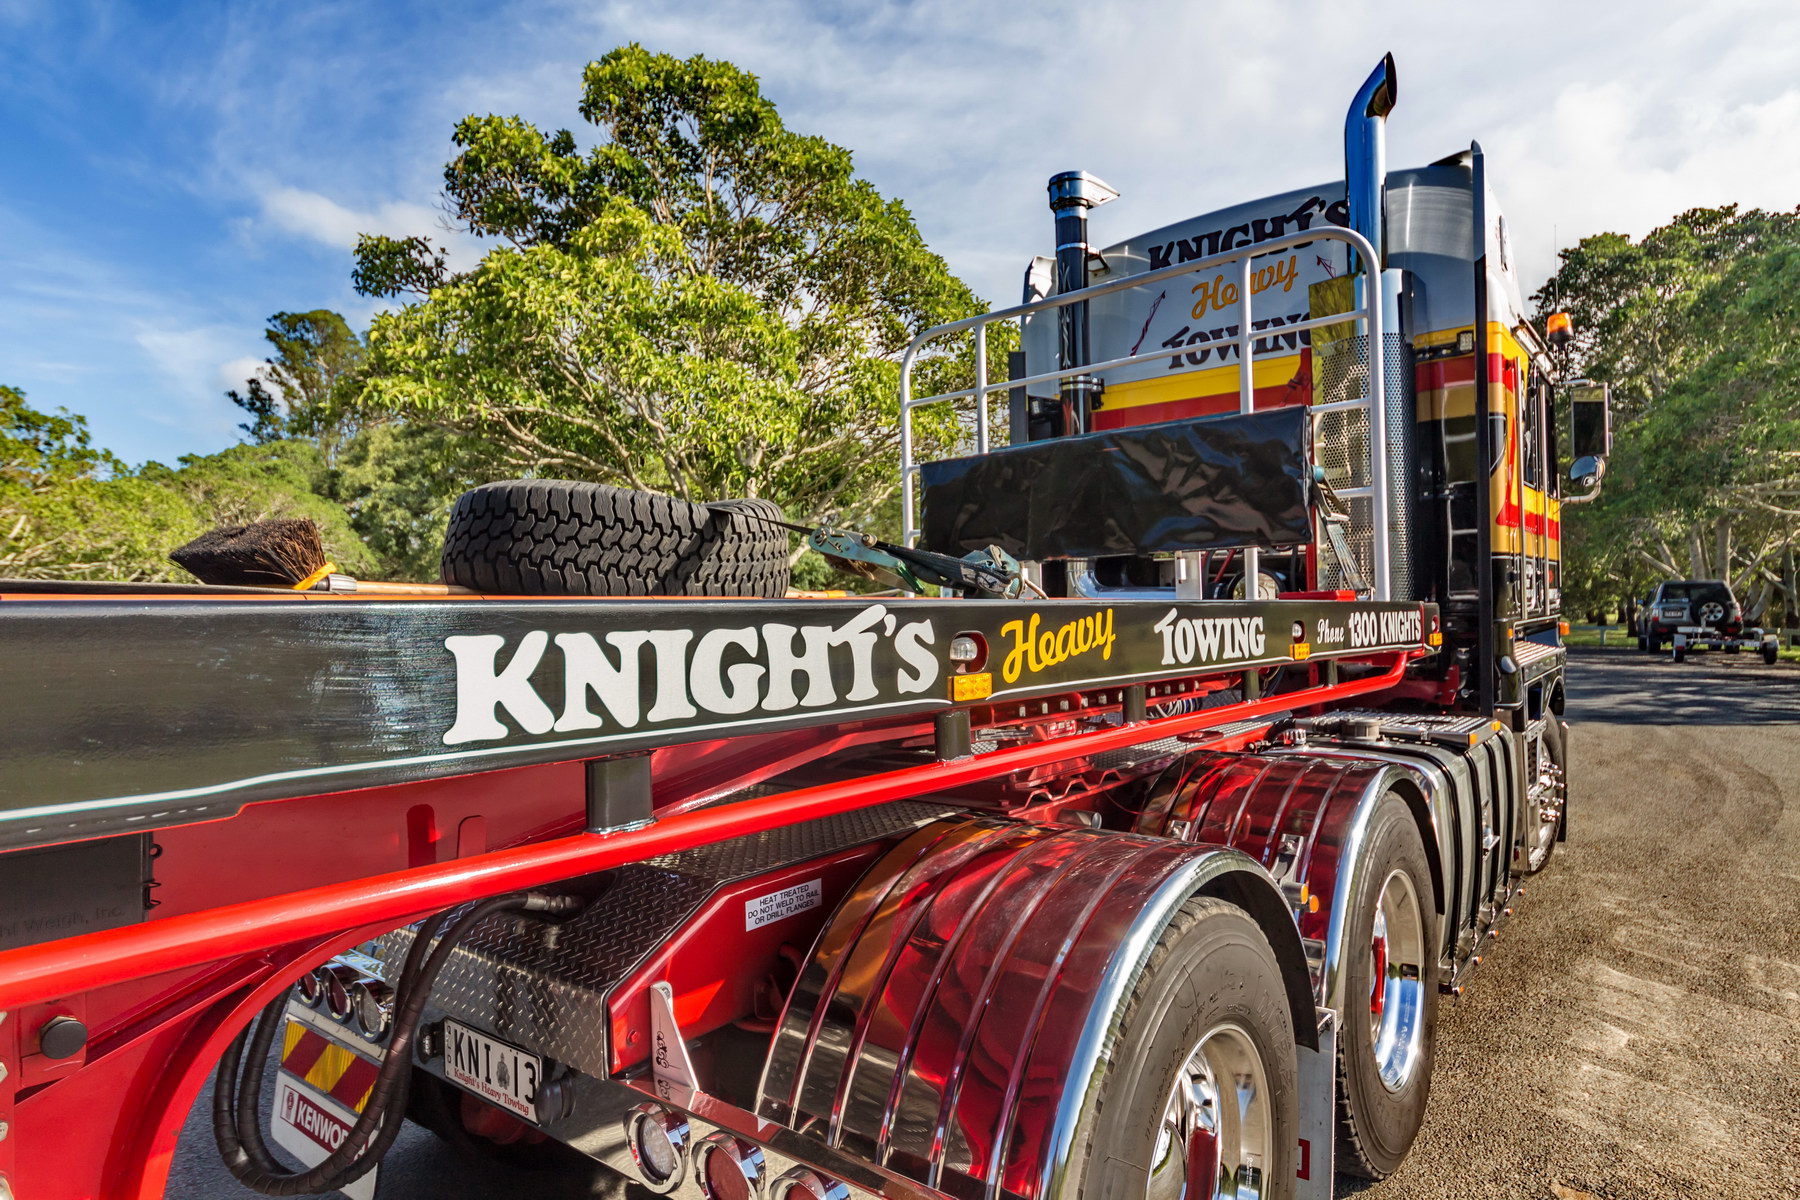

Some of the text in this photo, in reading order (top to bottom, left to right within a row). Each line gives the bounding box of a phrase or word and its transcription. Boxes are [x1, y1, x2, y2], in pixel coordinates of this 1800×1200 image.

[442, 604, 1421, 745] KNIGHT'S Heavy TOWING Phone 1300 KNIGHTS
[748, 910, 758, 919] DO
[760, 905, 774, 915] NOT
[776, 899, 794, 909] WELD
[806, 889, 819, 898] RAIL
[755, 899, 814, 925] OR DRILL FLANGES
[760, 885, 809, 905] HEAT TREATED
[454, 1030, 492, 1084] KNI
[454, 1068, 529, 1116] Knight's Heavy Towing
